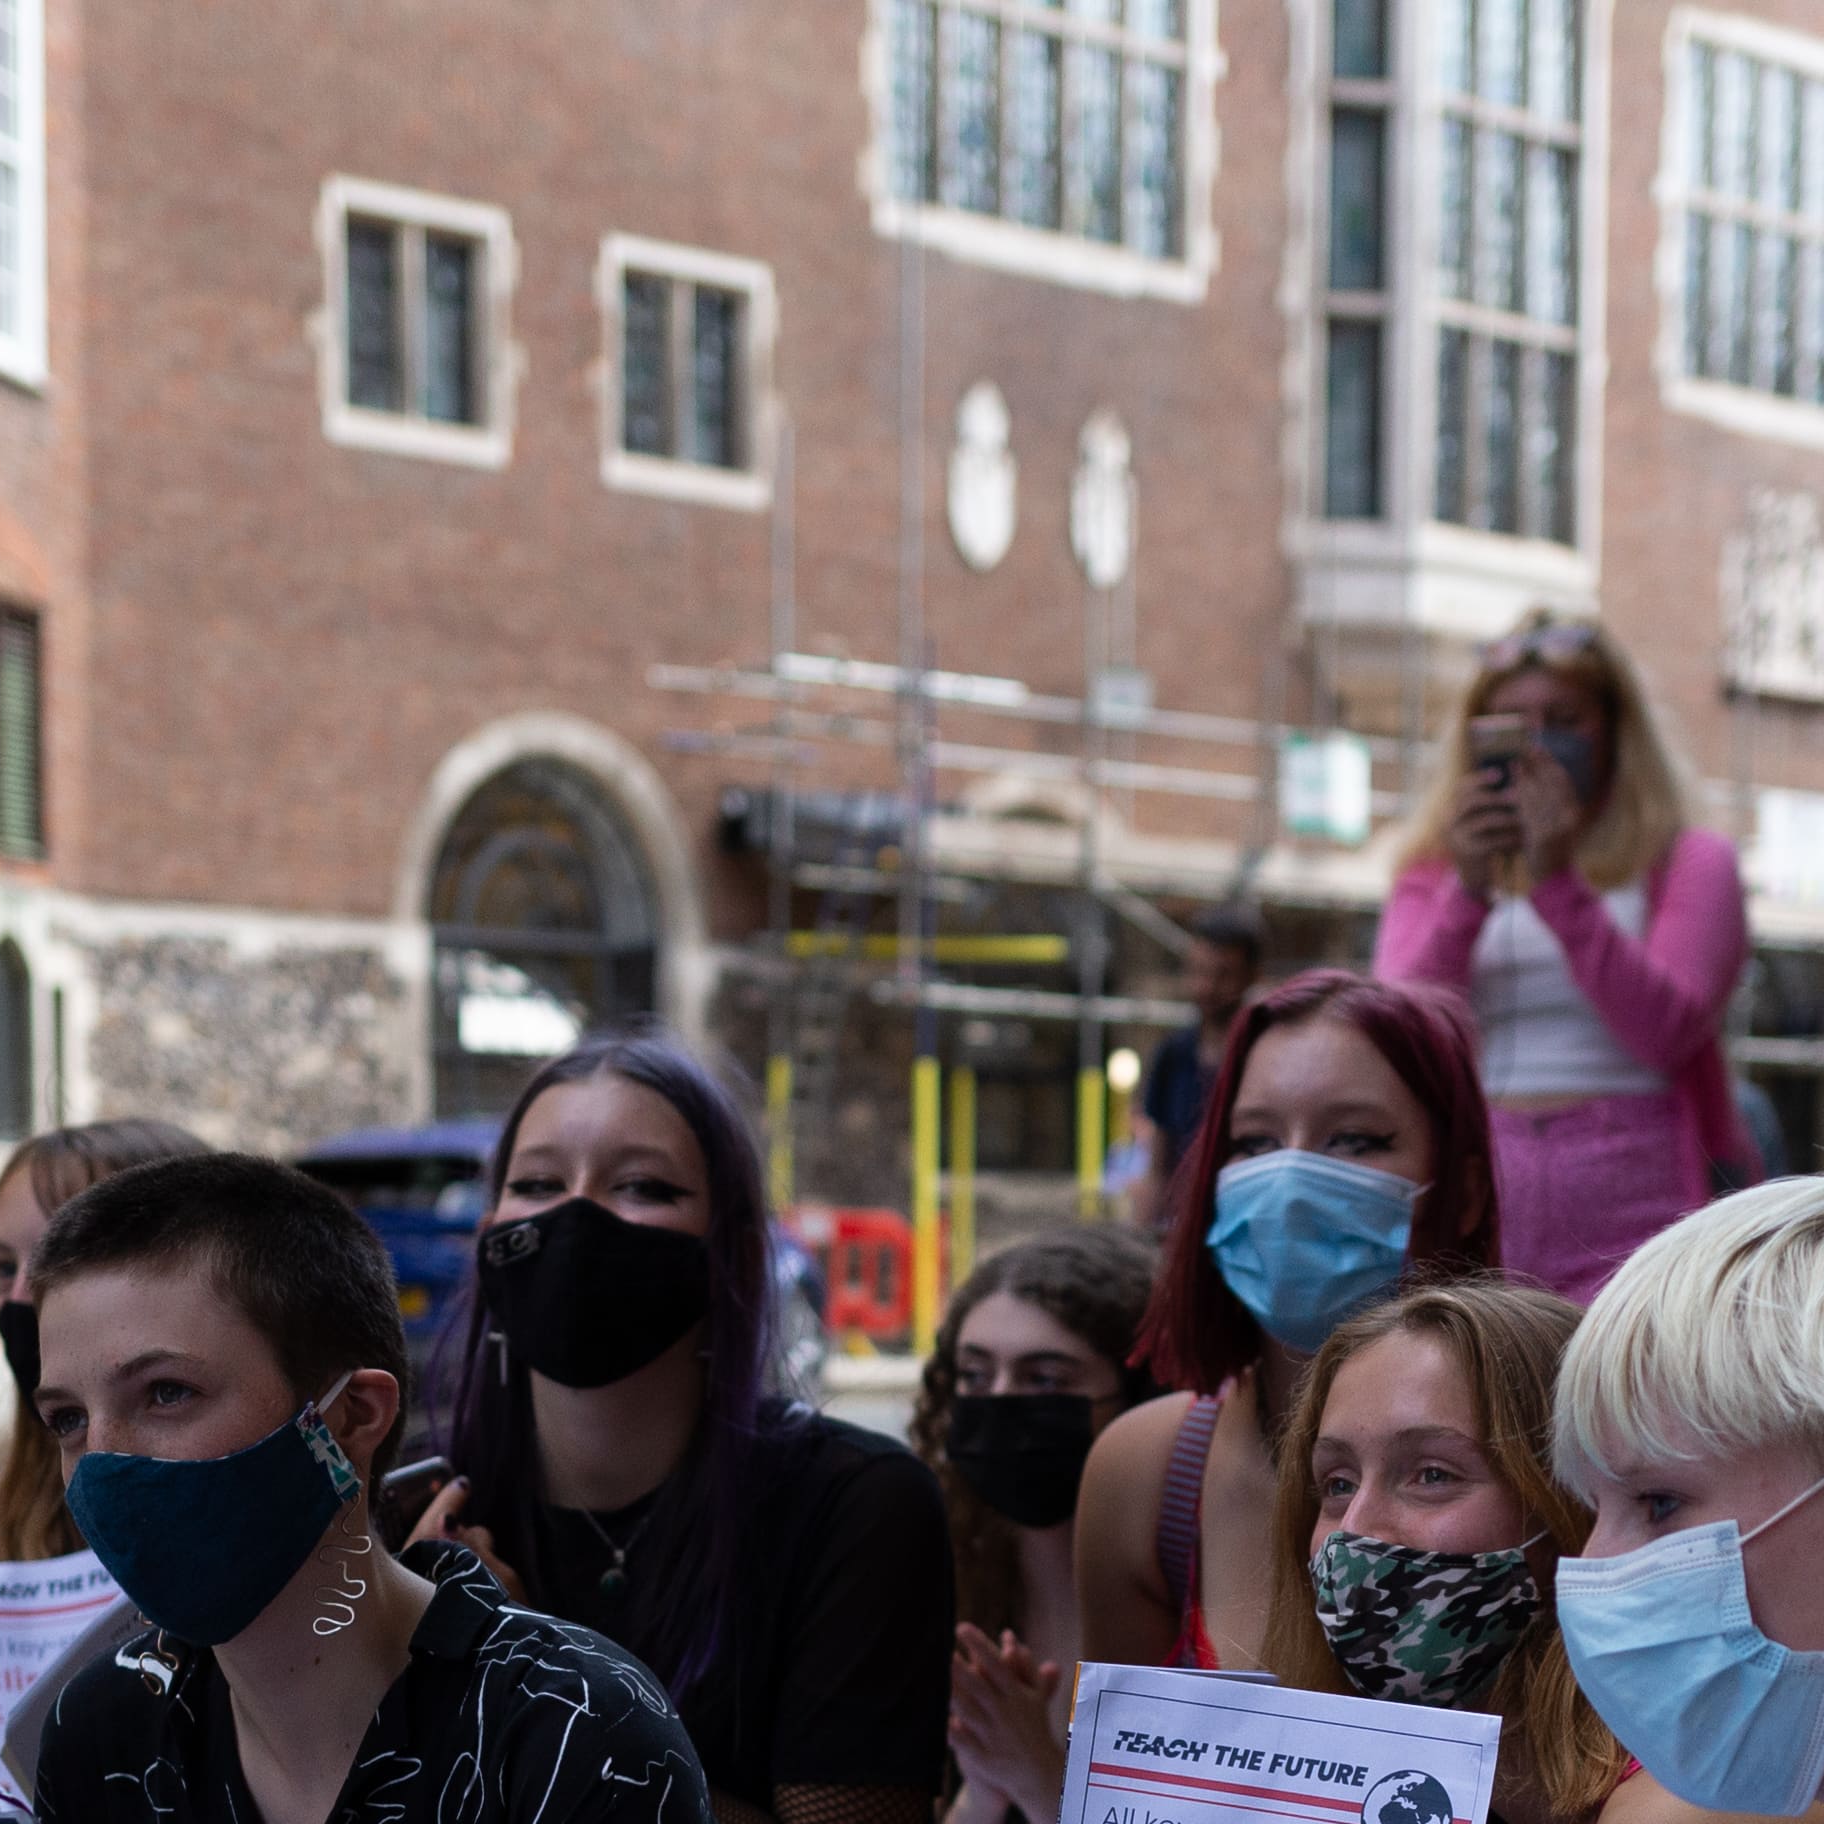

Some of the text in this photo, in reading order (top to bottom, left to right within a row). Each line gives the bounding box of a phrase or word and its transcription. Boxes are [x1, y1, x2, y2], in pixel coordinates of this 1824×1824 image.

[48, 1575, 83, 1596] THE
[1113, 1730, 1368, 1787] TEACH THE FUTURE
